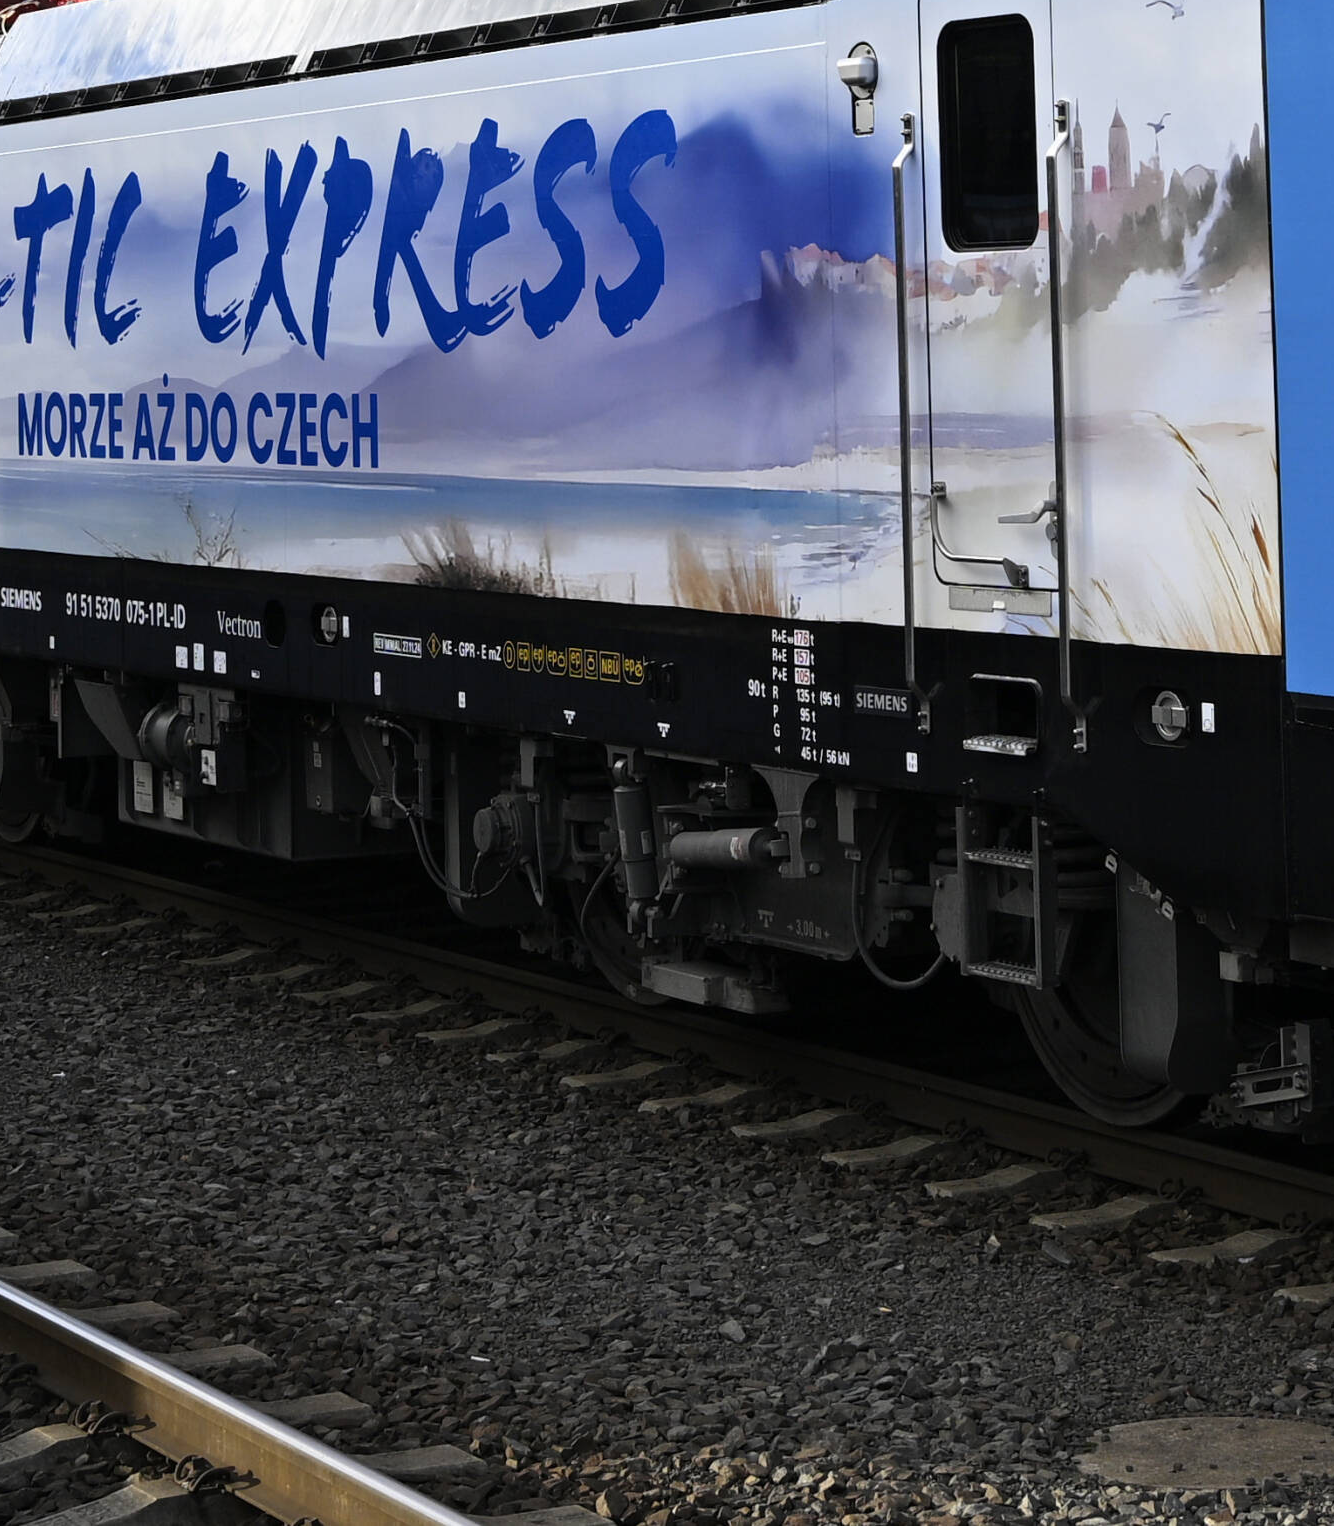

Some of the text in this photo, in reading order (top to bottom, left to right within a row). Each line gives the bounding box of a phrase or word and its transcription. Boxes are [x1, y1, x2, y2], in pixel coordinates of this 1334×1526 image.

[194, 109, 678, 361] EXPRESS
[17, 372, 380, 469] MORZE AŻ DO CZECH
[0, 586, 42, 612] SIEMENS
[66, 592, 187, 629] 91 51 5370 075-1 PL-ID
[217, 610, 262, 639] Vectron
[795, 631, 809, 645] 176
[442, 639, 453, 655] KE
[458, 641, 475, 658] GPR
[481, 644, 487, 660] E
[488, 646, 502, 662] mZ
[771, 648, 787, 663] R+E
[772, 666, 787, 682] P+E
[748, 679, 767, 698] 90 t
[772, 685, 779, 700] R
[796, 688, 811, 703] 135
[855, 692, 908, 713] SIEMENS
[773, 704, 779, 719] P
[799, 707, 811, 722] 95
[773, 723, 781, 737] G
[800, 727, 811, 741] 72
[800, 746, 812, 761] 45
[826, 749, 837, 765] 56
[837, 750, 850, 766] kN
